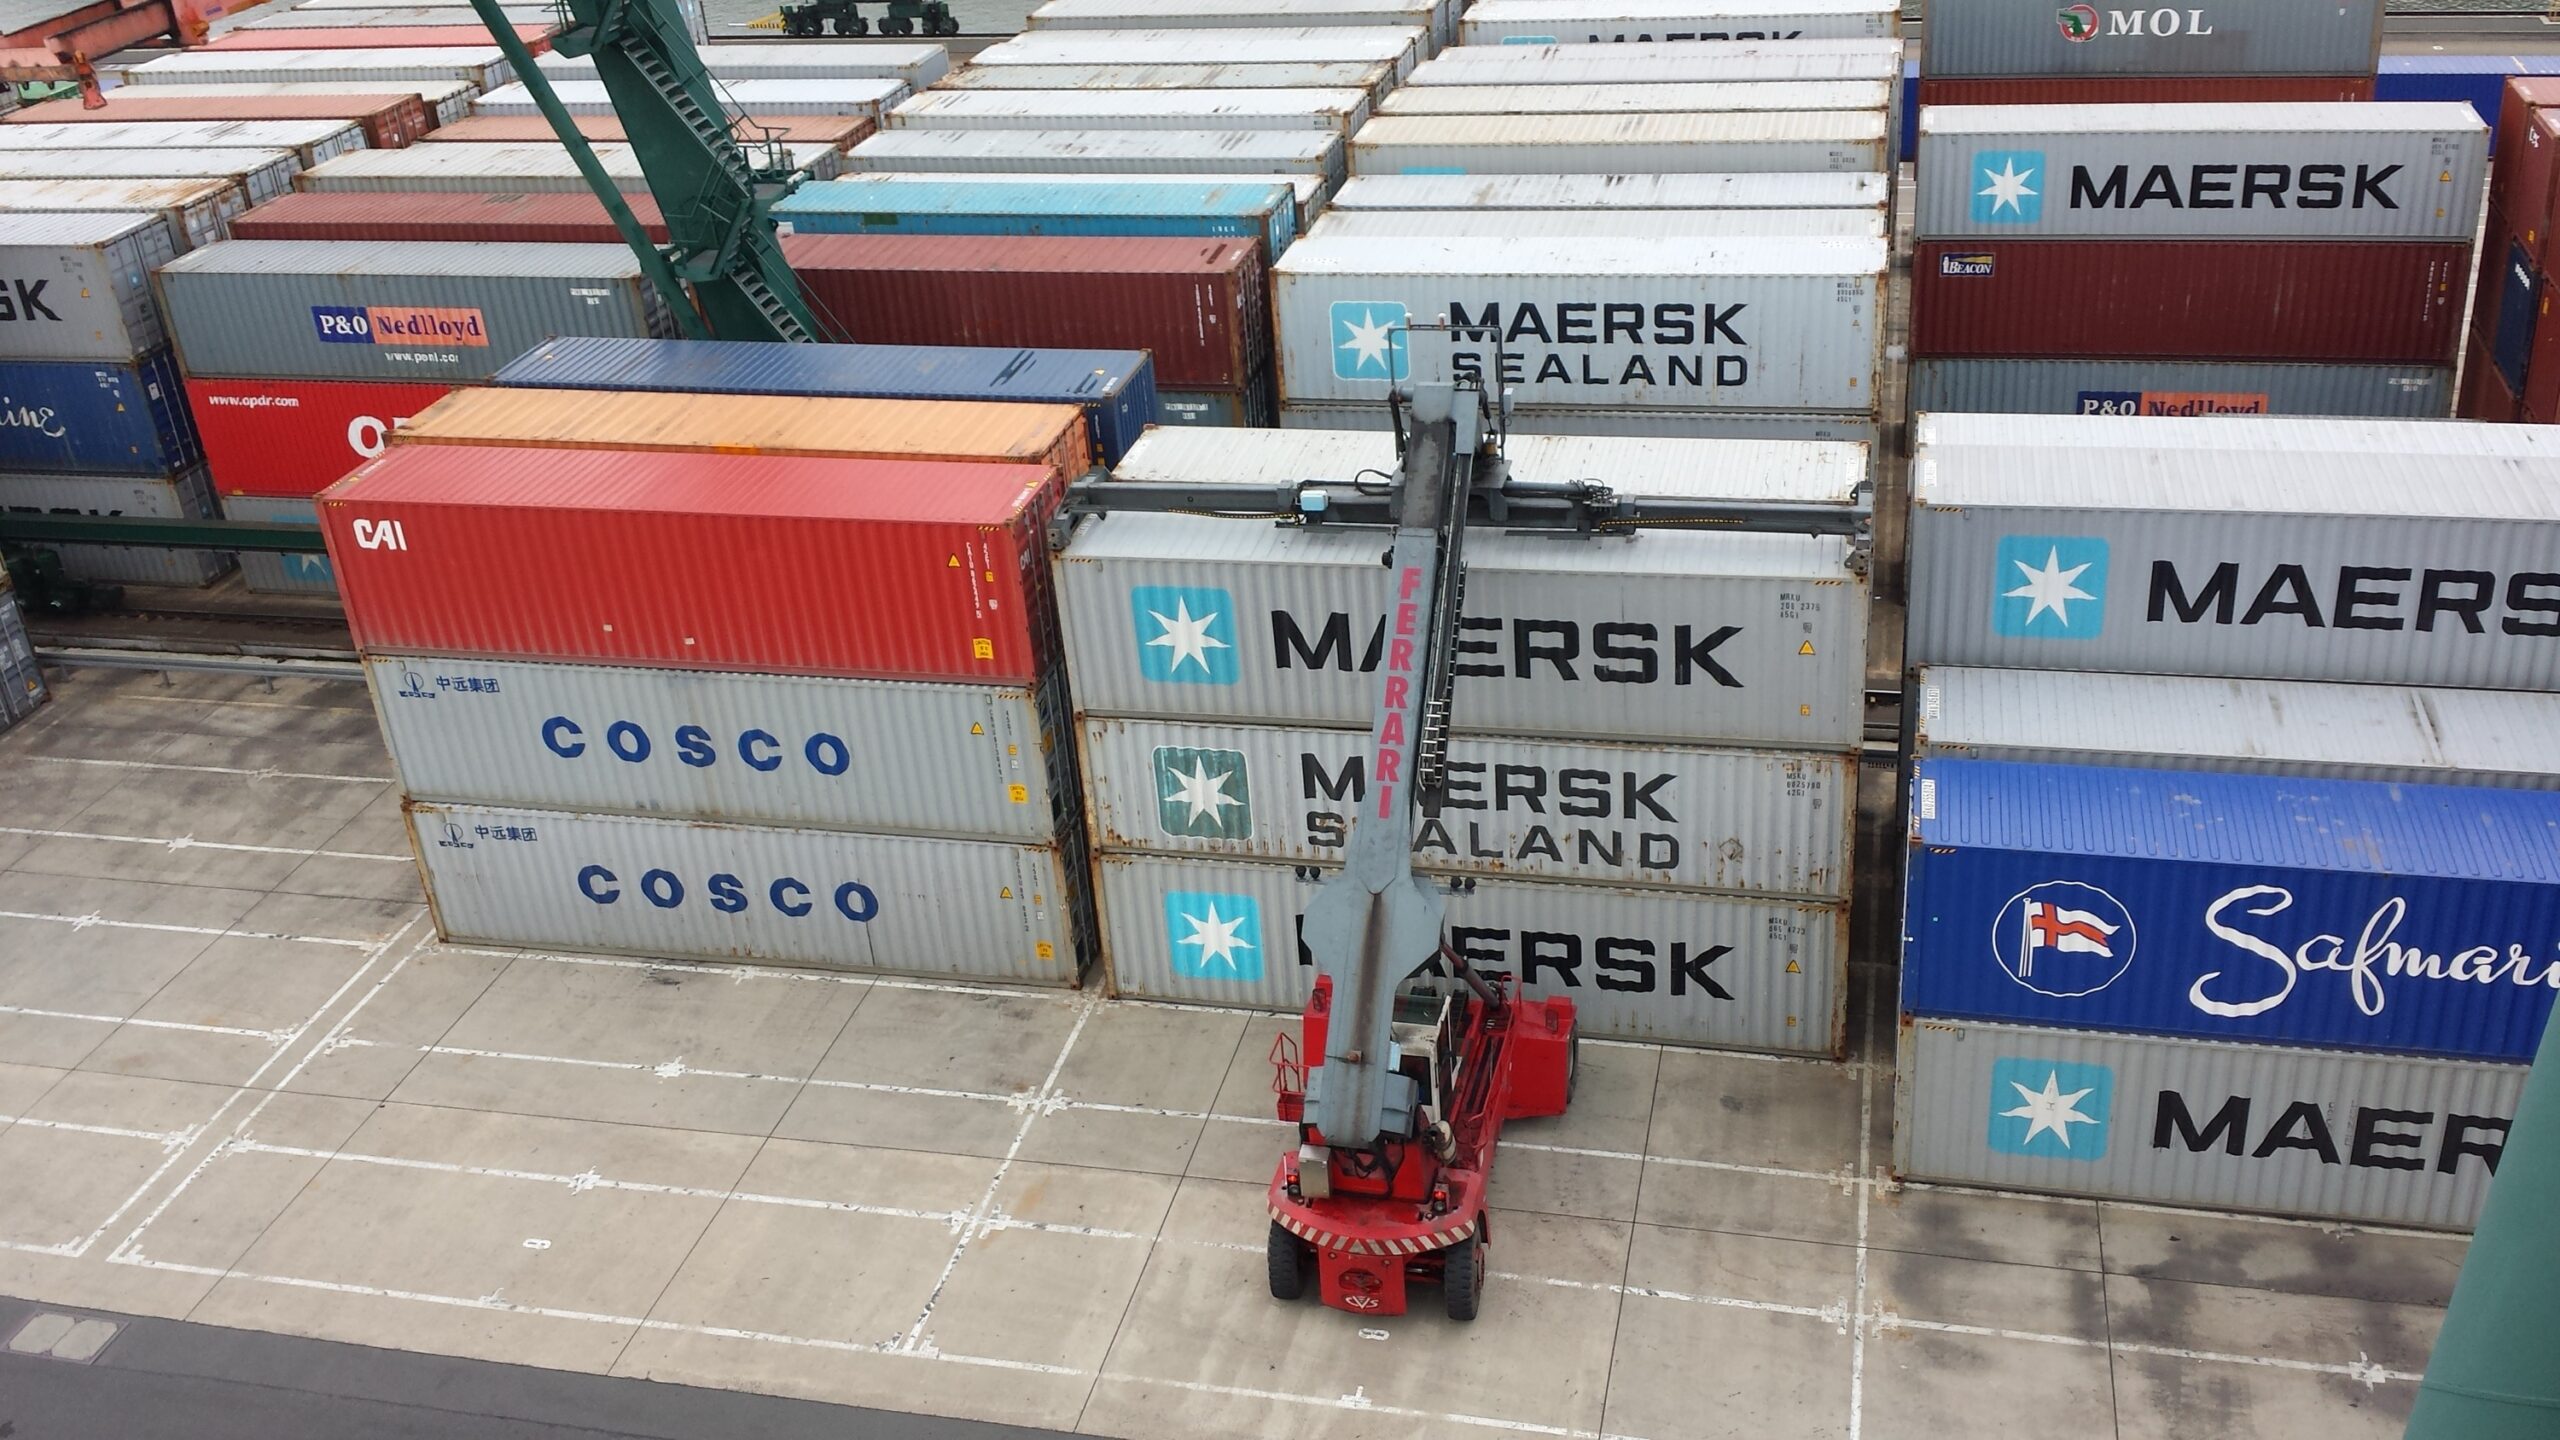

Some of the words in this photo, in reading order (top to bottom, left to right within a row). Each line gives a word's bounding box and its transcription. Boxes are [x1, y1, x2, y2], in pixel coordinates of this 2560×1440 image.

[2106, 8, 2213, 37] MOL
[2070, 164, 2405, 209] MAERSK
[319, 314, 369, 335] P&O
[378, 315, 481, 341] Nedlloyd
[1450, 302, 1748, 345] MAERSK
[1452, 352, 1748, 387] SEALAND
[208, 395, 299, 409] www.opdr.com
[2084, 399, 2137, 416] P&O
[348, 415, 412, 459] O
[353, 518, 407, 551] CAI
[1271, 609, 1745, 688] MERSK
[436, 675, 500, 693] 中远集团
[1376, 567, 1422, 820] FERRARI
[542, 715, 851, 776] COSCO
[1302, 752, 1679, 823] MERSK
[474, 824, 538, 842] 中远集团
[1306, 811, 1680, 871] SALAND
[578, 864, 880, 923] COSCO
[1295, 913, 1736, 1001] ERSK
[1345, 1295, 1380, 1310] CVS
